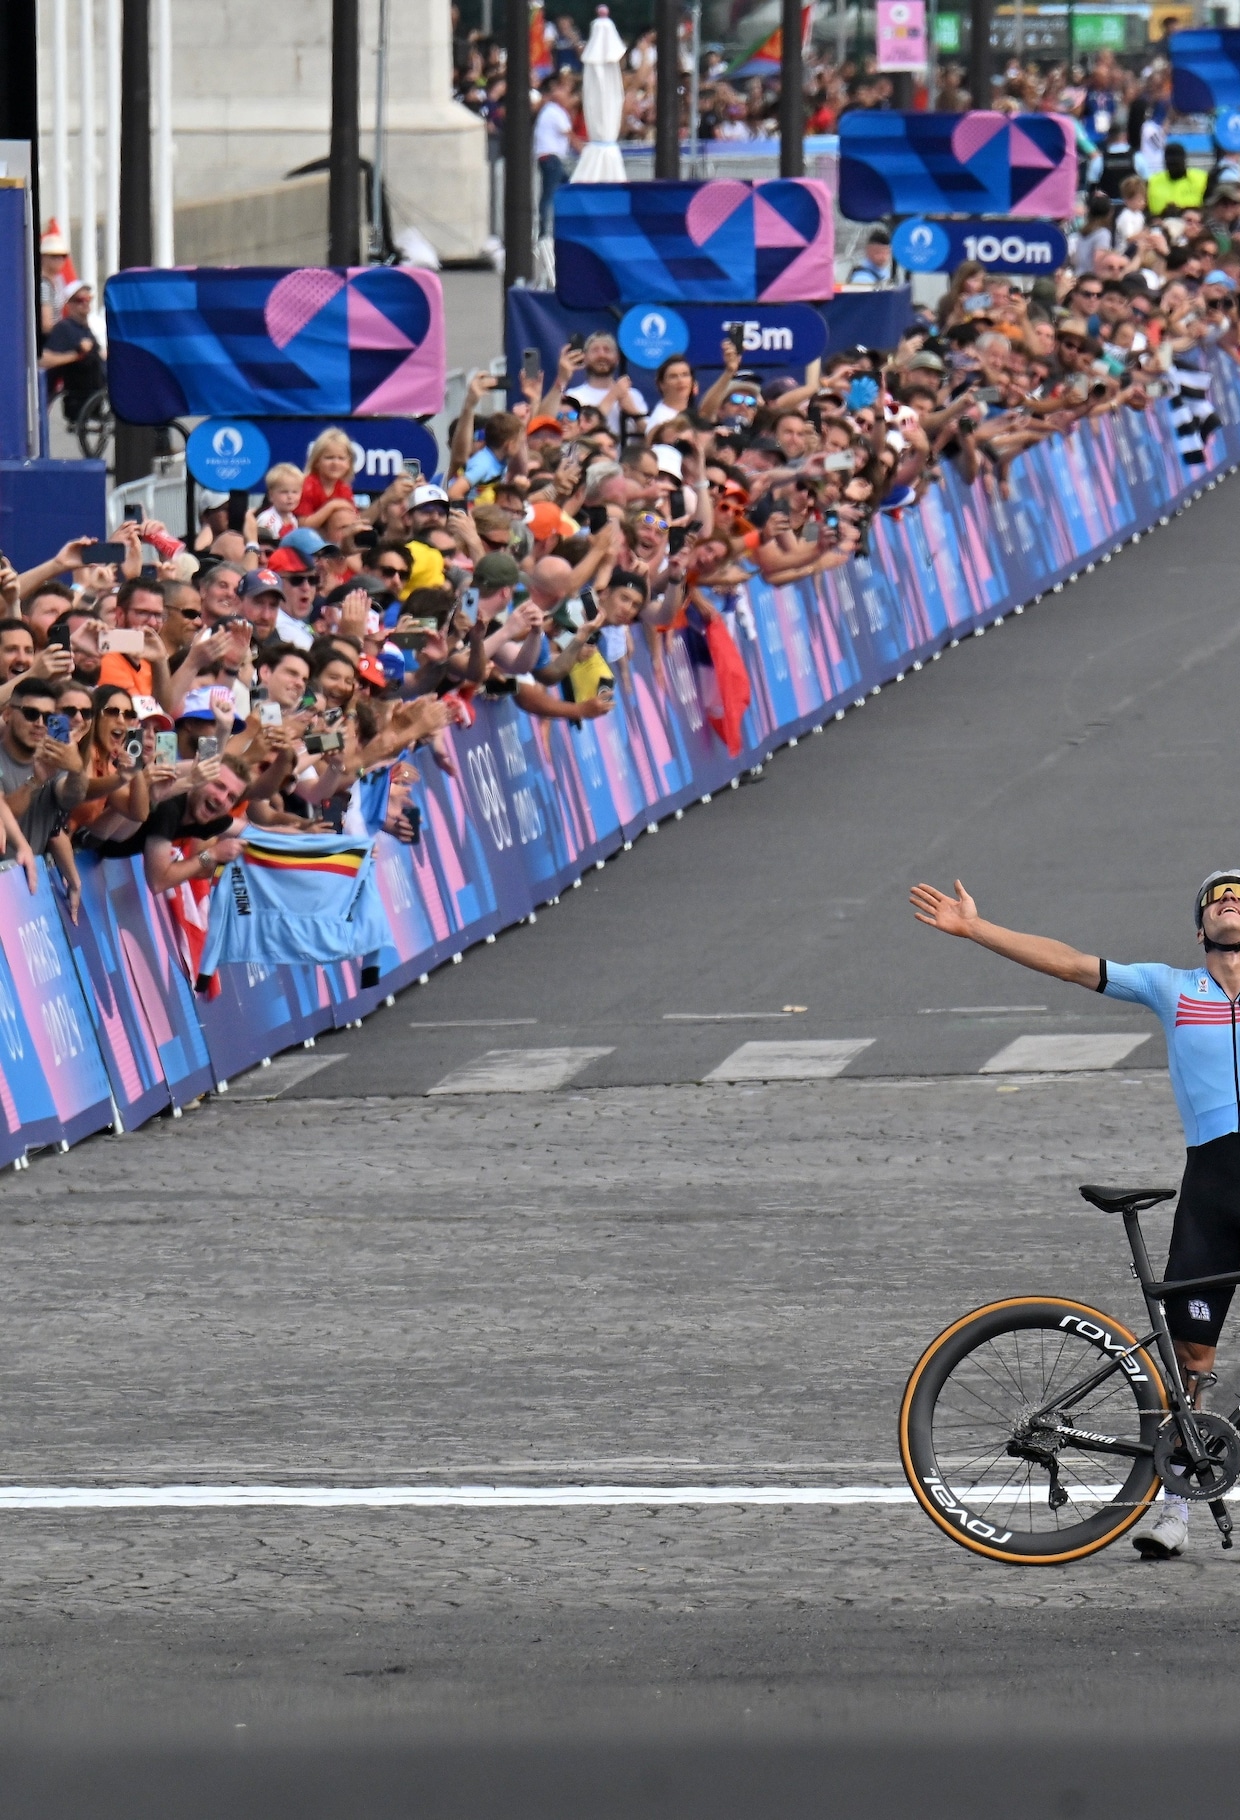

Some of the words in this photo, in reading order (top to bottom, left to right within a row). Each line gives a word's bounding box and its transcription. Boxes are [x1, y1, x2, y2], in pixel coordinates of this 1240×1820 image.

[963, 235, 1052, 263] 100m
[721, 320, 793, 350] 5m
[18, 915, 62, 987] PARIS
[42, 993, 84, 1066] 2024
[1056, 1425, 1117, 1444] SPECIALIZED
[922, 1476, 1013, 1544] roval
